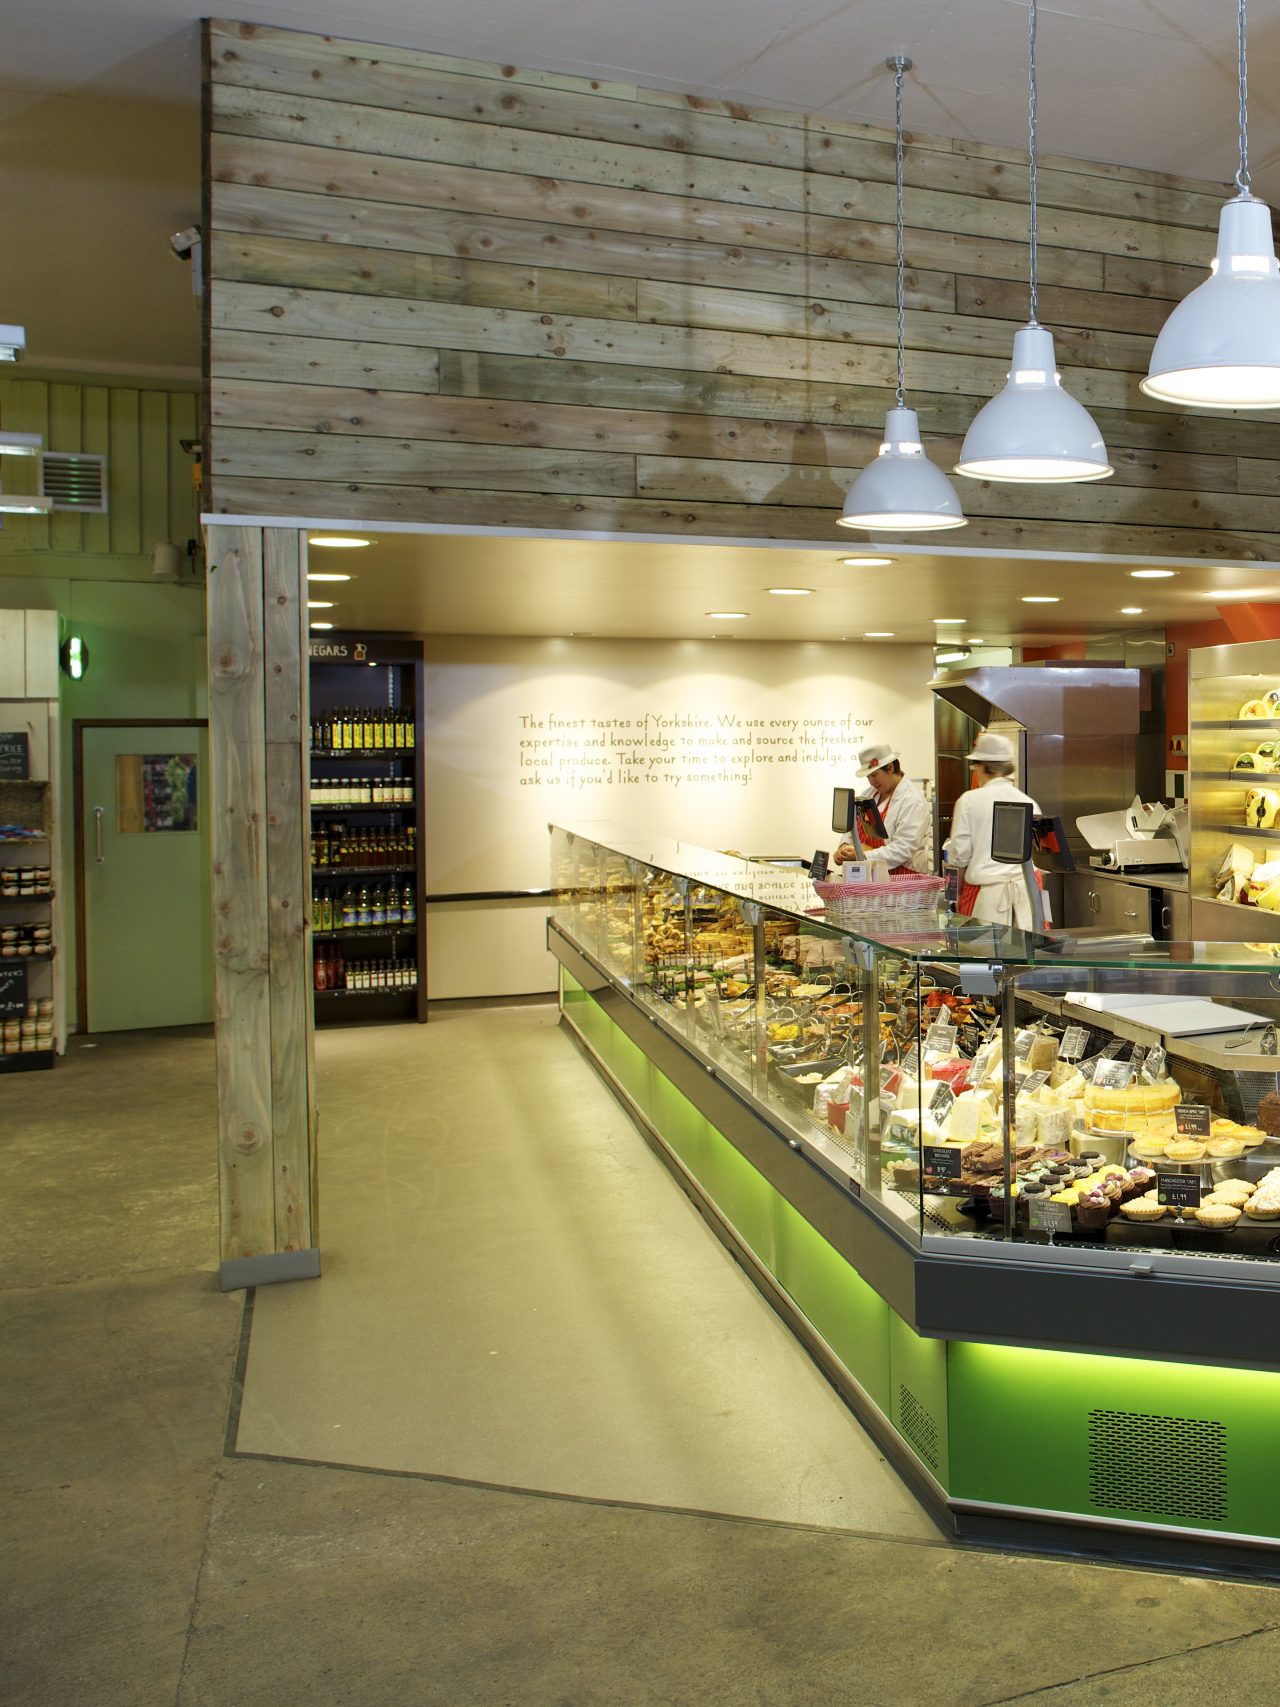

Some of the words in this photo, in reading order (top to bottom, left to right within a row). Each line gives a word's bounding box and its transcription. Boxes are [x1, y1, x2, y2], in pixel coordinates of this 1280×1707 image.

[309, 645, 348, 657] EGARS
[519, 713, 544, 729] The
[548, 713, 586, 731] finest
[591, 718, 631, 729] tastes
[636, 713, 649, 731] of
[651, 713, 713, 729] Yorkshire.
[717, 714, 742, 728] We
[746, 719, 765, 728] use
[769, 719, 799, 732] every
[803, 719, 836, 728] ounce
[839, 713, 852, 730] of
[855, 718, 874, 727] our
[519, 734, 579, 752] expertise
[584, 732, 606, 748] and
[610, 732, 676, 752] knowledge
[680, 737, 693, 746] to
[698, 732, 727, 746] make
[732, 731, 752, 746] and
[756, 736, 794, 745] source
[798, 731, 817, 745] the
[819, 730, 865, 749] freshest
[520, 751, 553, 767] local
[559, 751, 612, 772] produce.
[616, 750, 645, 765] Take
[649, 755, 676, 770] your
[681, 751, 707, 764] time
[713, 754, 725, 764] to
[731, 750, 774, 768] explore
[777, 749, 798, 763] and
[519, 770, 541, 786] ask
[546, 777, 561, 786] us
[566, 769, 576, 788] if
[580, 769, 613, 790] you'd
[618, 768, 640, 784] like
[644, 773, 658, 783] to
[663, 772, 682, 787] try
[686, 768, 753, 786] something!
[1171, 1193, 1187, 1201] £1.99
